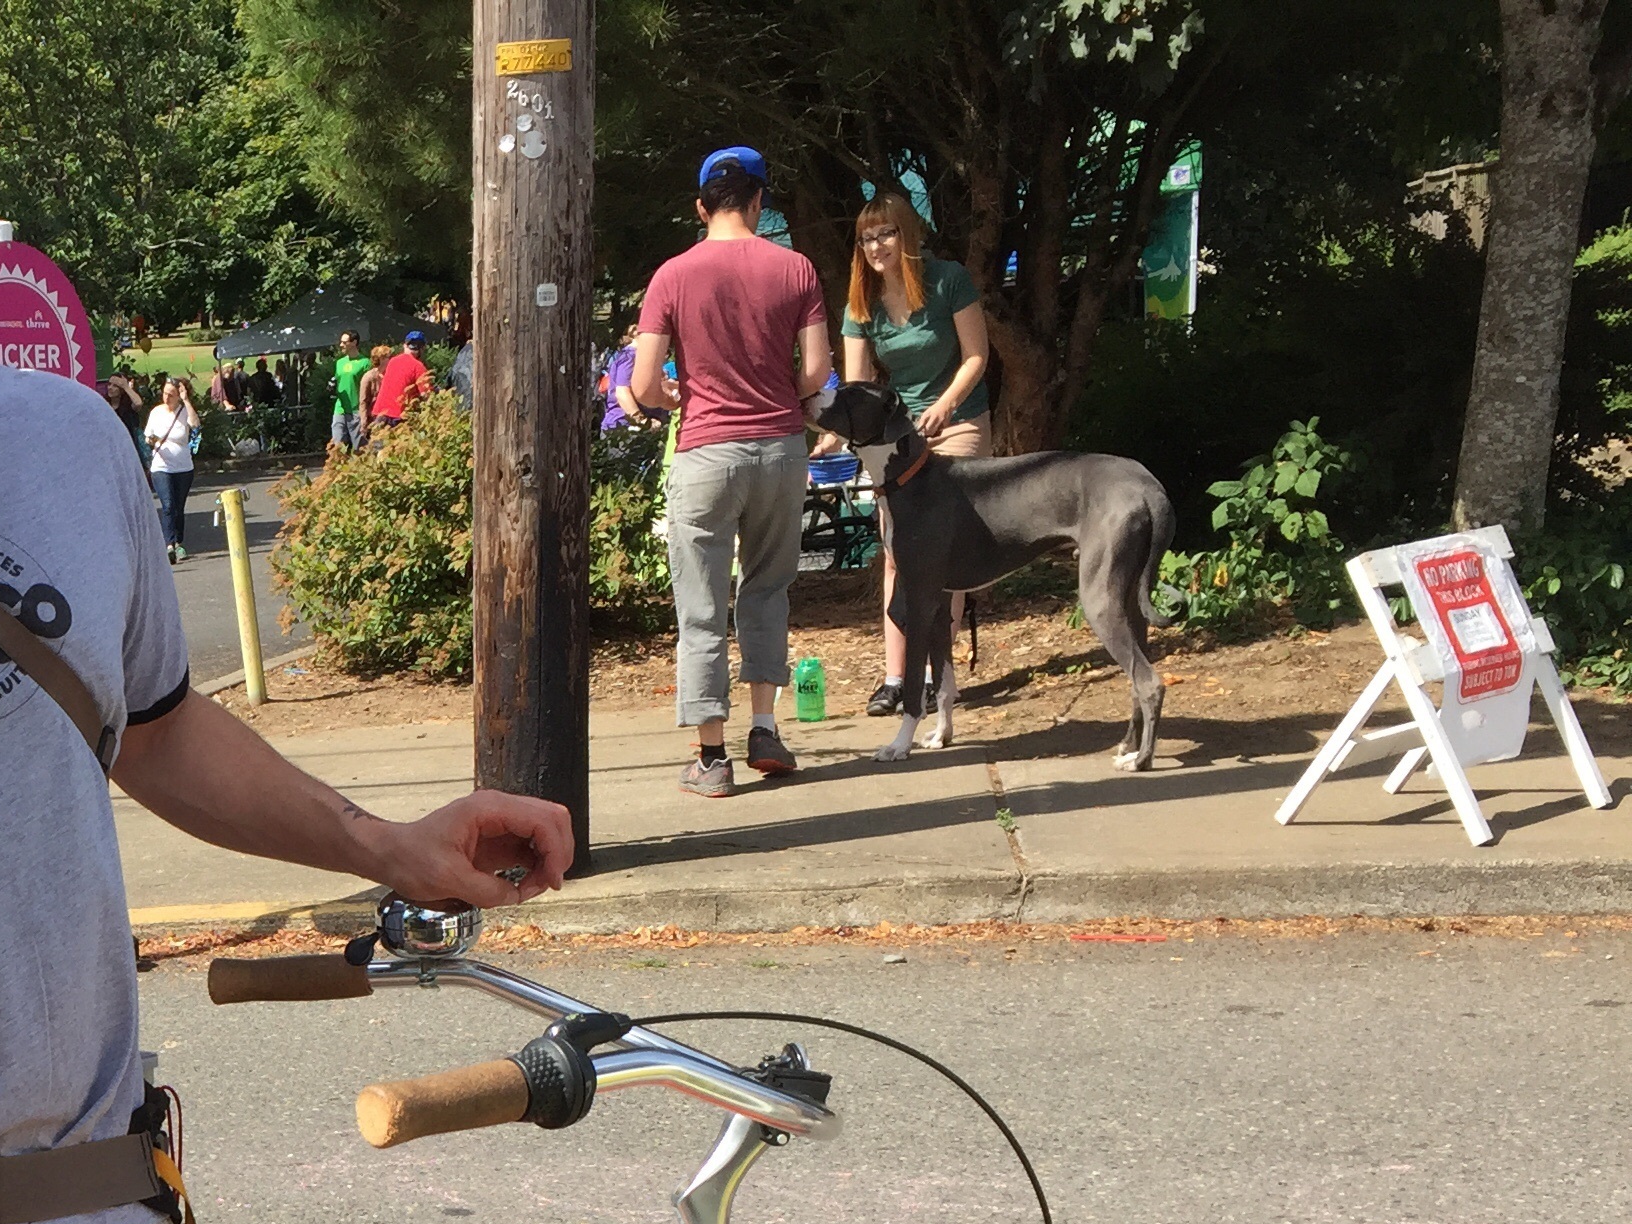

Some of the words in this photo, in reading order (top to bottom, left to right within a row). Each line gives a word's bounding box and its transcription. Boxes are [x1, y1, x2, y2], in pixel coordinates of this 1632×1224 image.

[506, 80, 555, 119] 2601
[25, 317, 51, 329] thrive
[1422, 566, 1439, 588] NO
[1439, 556, 1480, 585] PARKING
[1455, 584, 1485, 602] BLOCK
